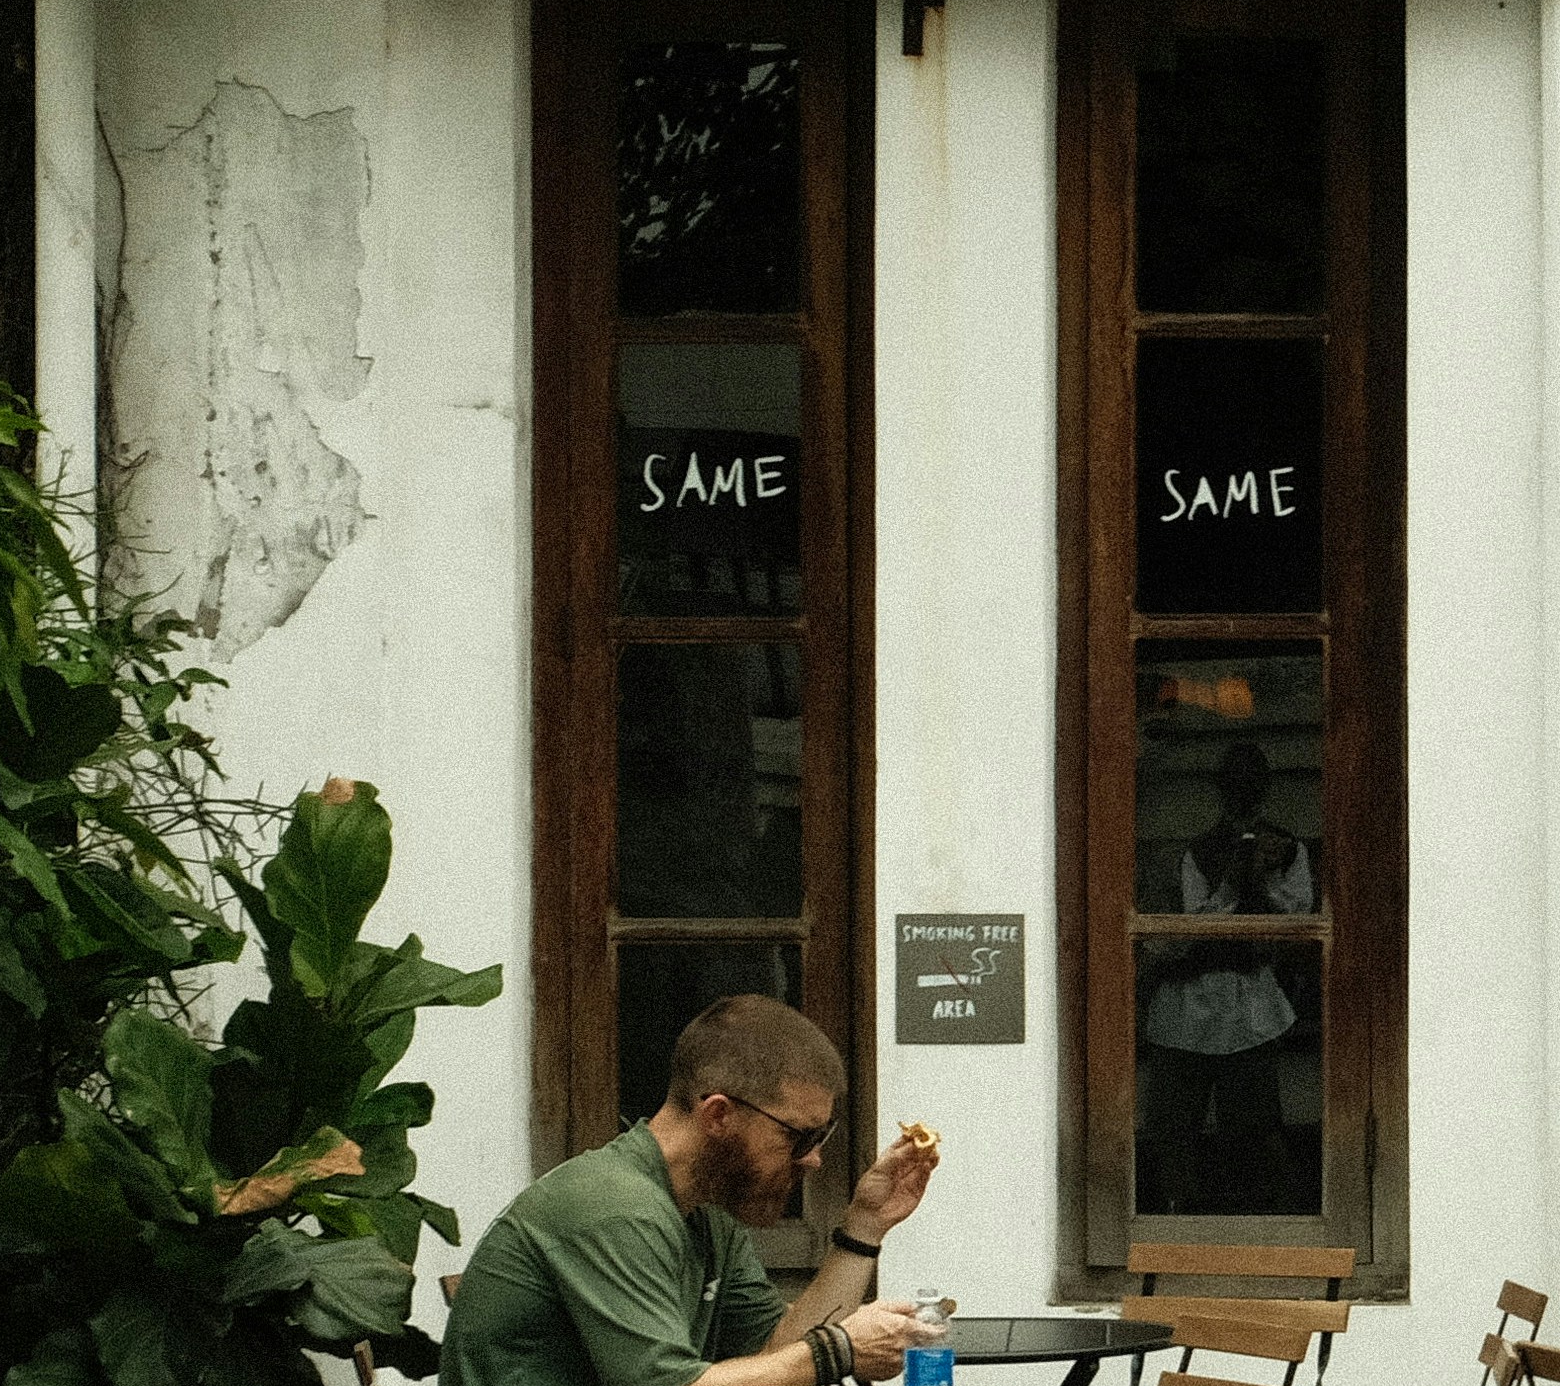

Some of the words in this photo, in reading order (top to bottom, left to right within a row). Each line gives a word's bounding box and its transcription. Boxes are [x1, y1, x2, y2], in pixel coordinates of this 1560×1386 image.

[640, 451, 787, 512] SAME
[1160, 466, 1296, 522] SAME
[902, 925, 975, 943] SMOKING
[982, 925, 1018, 943] FREE
[933, 1000, 976, 1019] AREA
